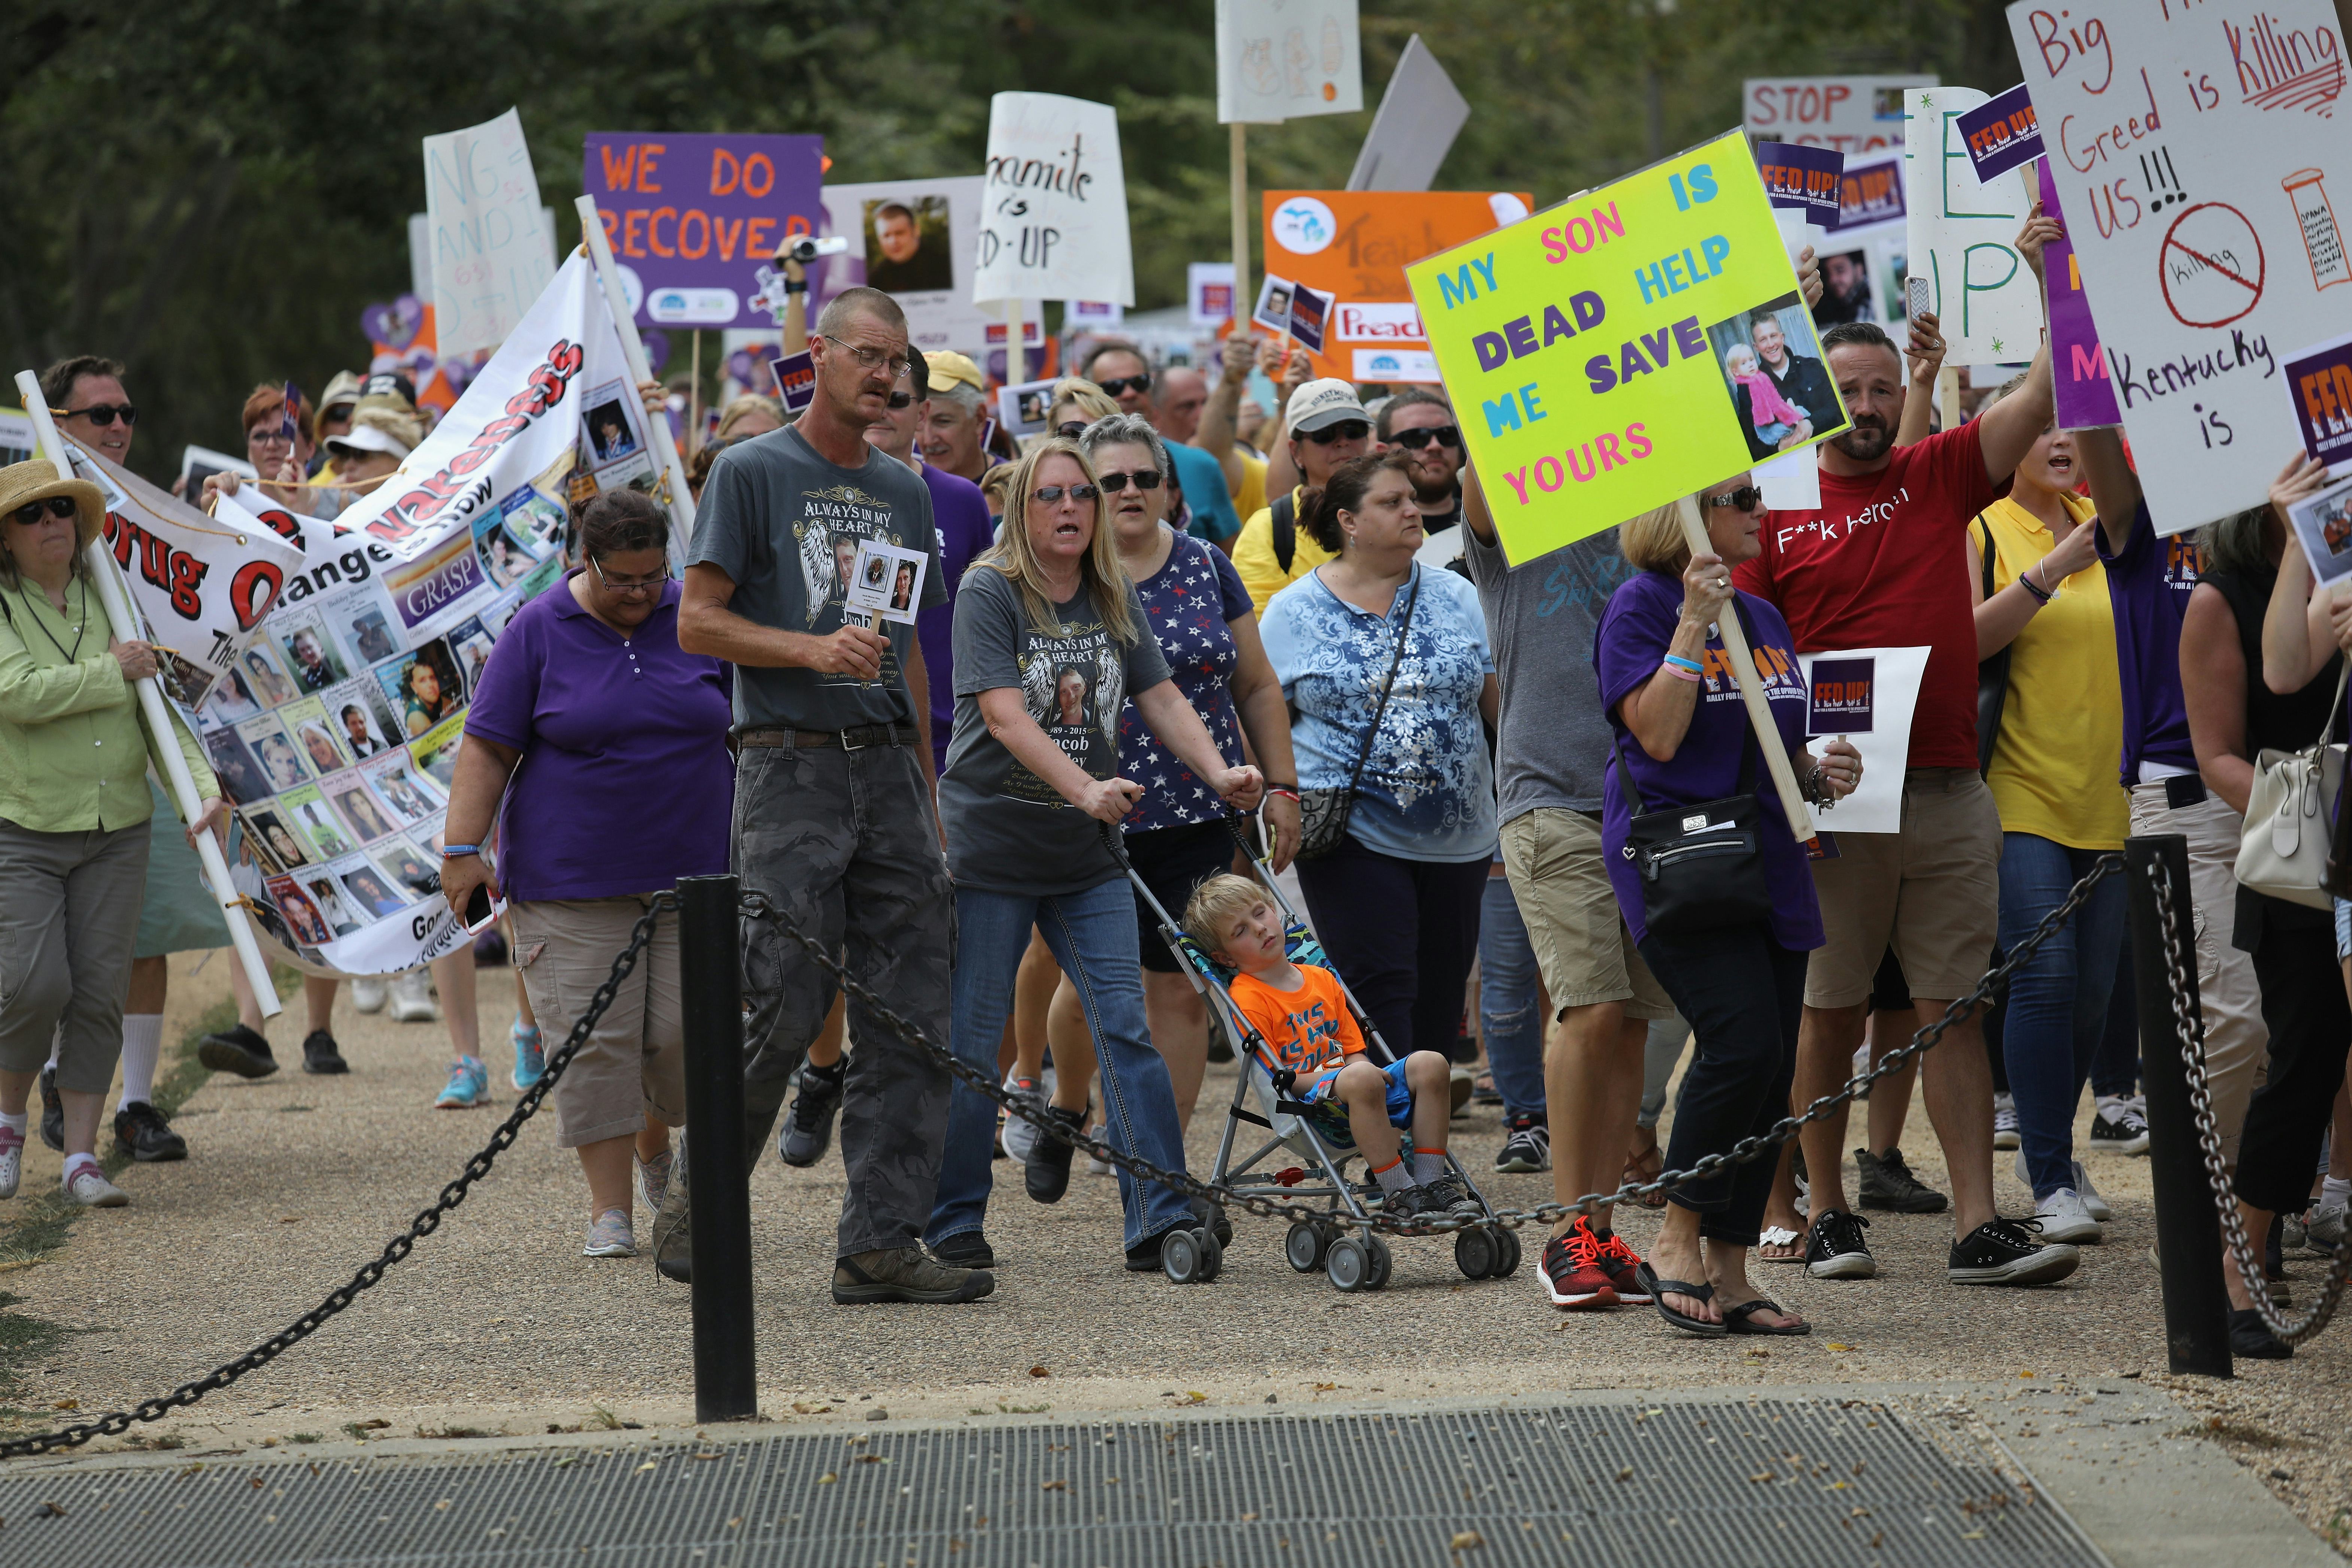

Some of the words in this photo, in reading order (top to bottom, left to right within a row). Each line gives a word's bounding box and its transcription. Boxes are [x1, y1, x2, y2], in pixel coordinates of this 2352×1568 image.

[2029, 10, 2113, 94] Big
[1751, 85, 1852, 124] STOP
[2061, 66, 2161, 173] Greed
[2183, 70, 2219, 112] is
[2223, 12, 2342, 99] Killing
[1969, 120, 2010, 157] FED
[600, 143, 666, 193] WE
[710, 148, 775, 198] DO
[1762, 165, 1803, 194] FED
[998, 194, 1029, 216] is
[437, 207, 514, 264] AND
[1437, 252, 1498, 309] MY
[1541, 201, 1626, 264] SON
[1668, 164, 1718, 212] IS
[1472, 290, 1606, 373] DEAD
[1635, 234, 1730, 304] HELP
[1482, 382, 1548, 439] ME
[1585, 315, 1708, 395] SAVE
[2109, 329, 2276, 409] Kentucky
[2193, 403, 2234, 449] is
[1502, 421, 1653, 506] YOURS
[804, 501, 860, 519] ALWAYS
[861, 508, 872, 521] IN
[874, 511, 892, 528] MY
[829, 518, 872, 535] HEART
[407, 555, 472, 618] GRASP
[207, 628, 238, 668] The
[1052, 650, 1094, 663] HEART
[1079, 638, 1093, 650] IN
[1706, 693, 1724, 702] RALLY
[1725, 692, 1737, 701] FOR
[1815, 683, 1843, 708] FED
[1023, 782, 1042, 791] walk
[1280, 1038, 1305, 1062] IS
